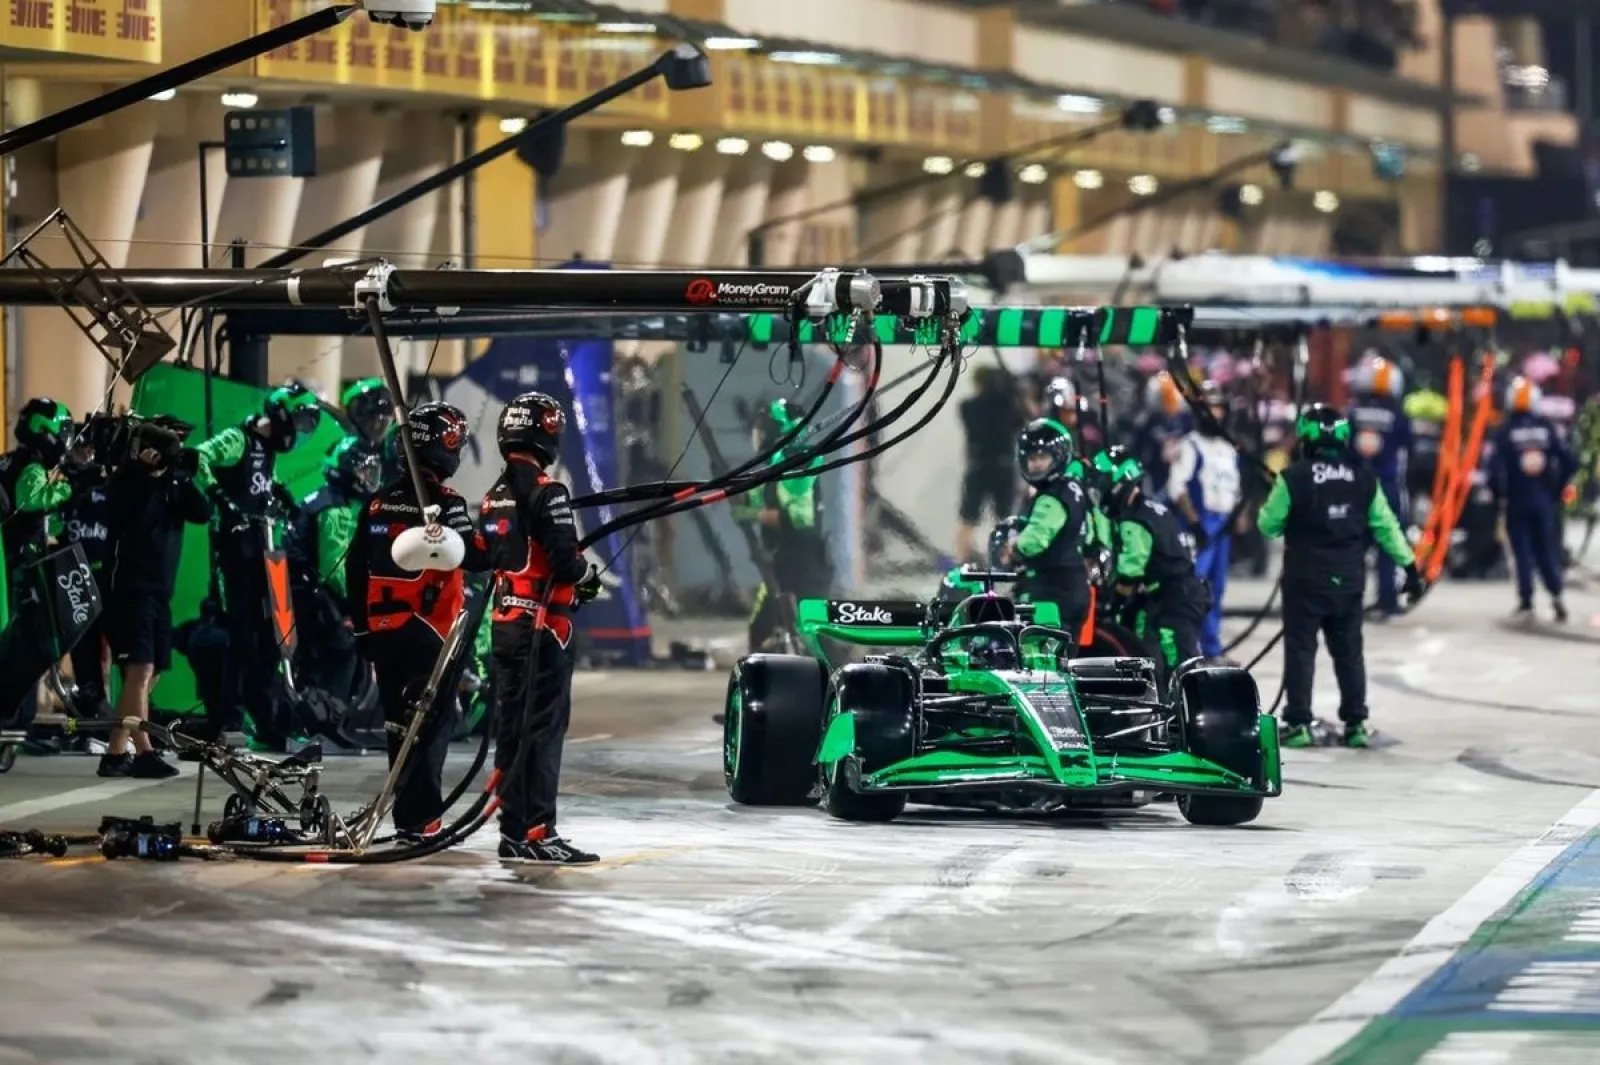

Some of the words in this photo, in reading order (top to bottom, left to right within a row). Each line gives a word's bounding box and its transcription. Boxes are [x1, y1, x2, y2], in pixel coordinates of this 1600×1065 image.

[718, 283, 789, 297] MoneyGram
[67, 519, 108, 542] Stake
[57, 569, 89, 625] Stake
[838, 602, 893, 624] Stake
